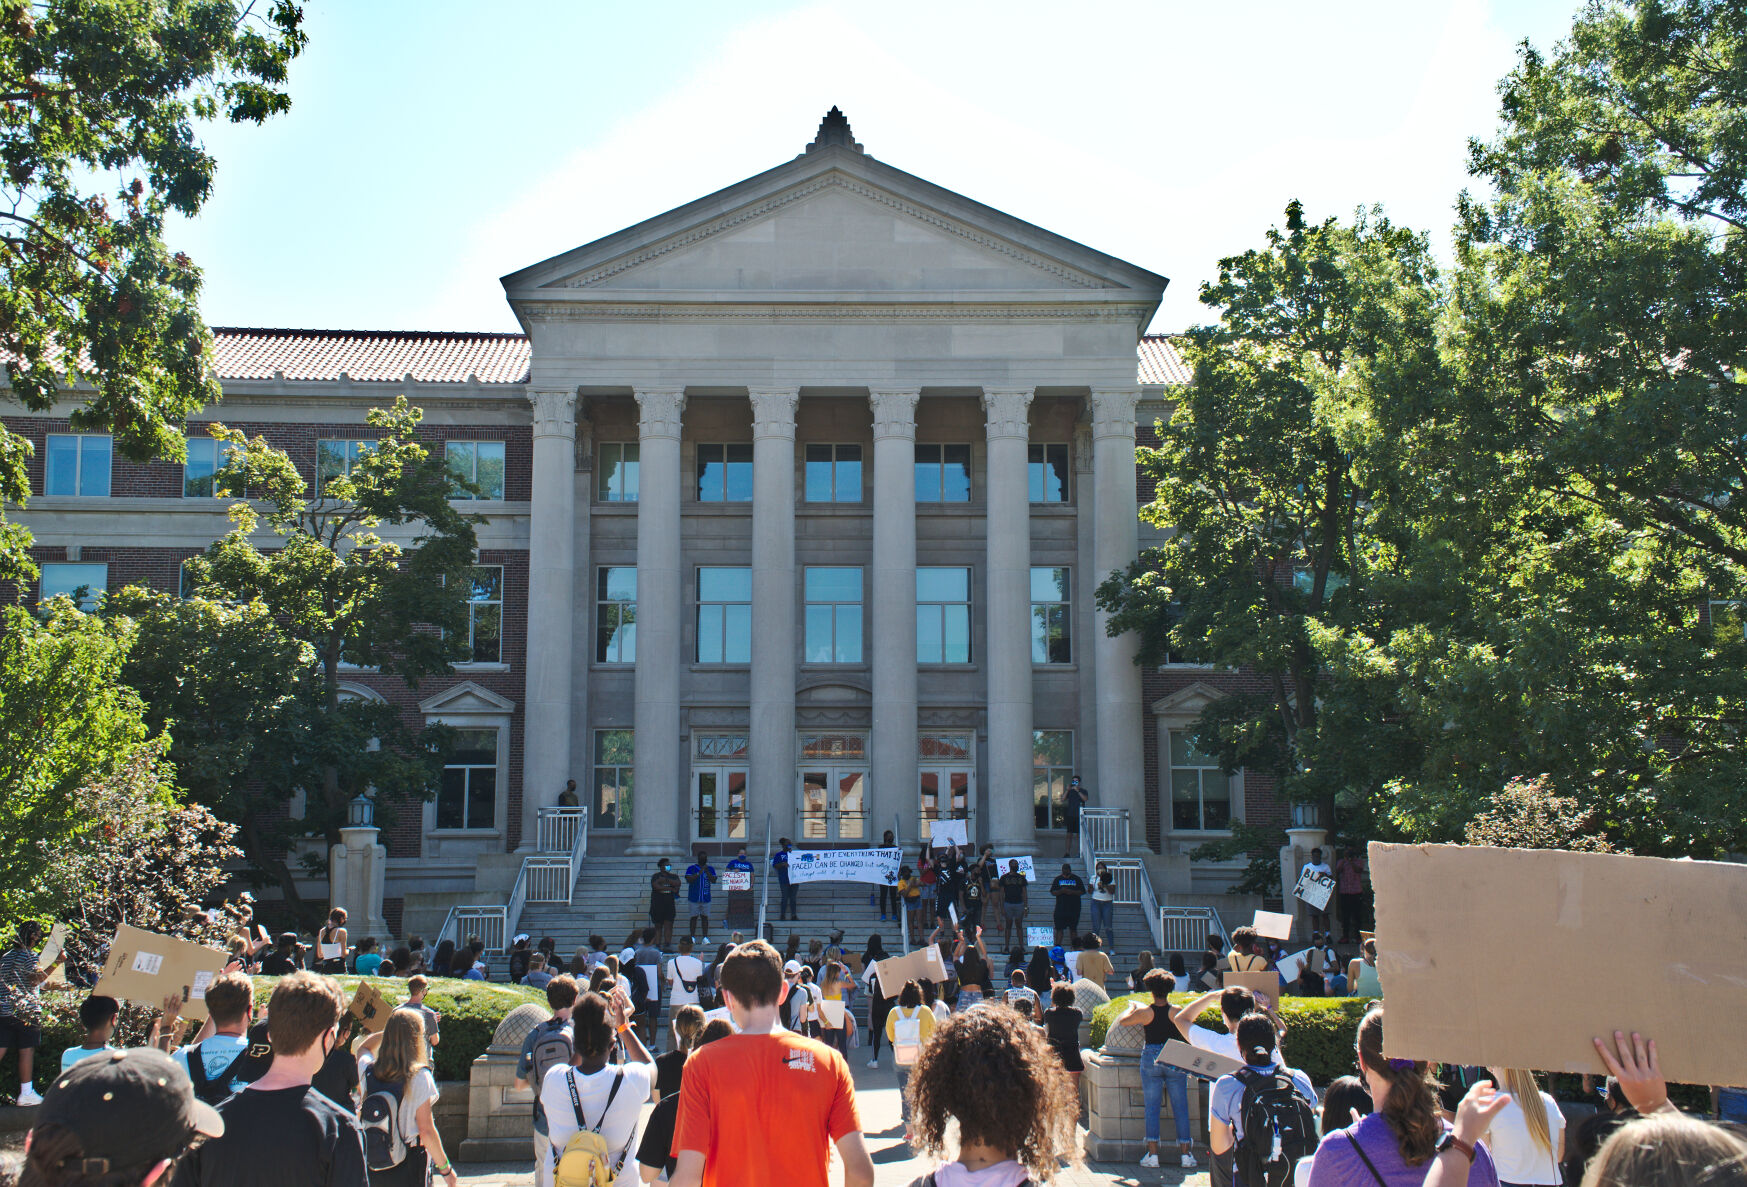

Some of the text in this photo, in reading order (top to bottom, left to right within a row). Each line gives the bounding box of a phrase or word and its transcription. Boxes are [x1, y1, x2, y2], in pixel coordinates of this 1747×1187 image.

[875, 850, 892, 858] THAT
[893, 851, 900, 861] IS
[791, 862, 812, 871] FACED
[814, 861, 828, 869] CAN
[829, 860, 838, 868] BE
[839, 860, 863, 868] CHANGED
[1303, 868, 1335, 891] BLACK
[250, 1043, 271, 1058] P
